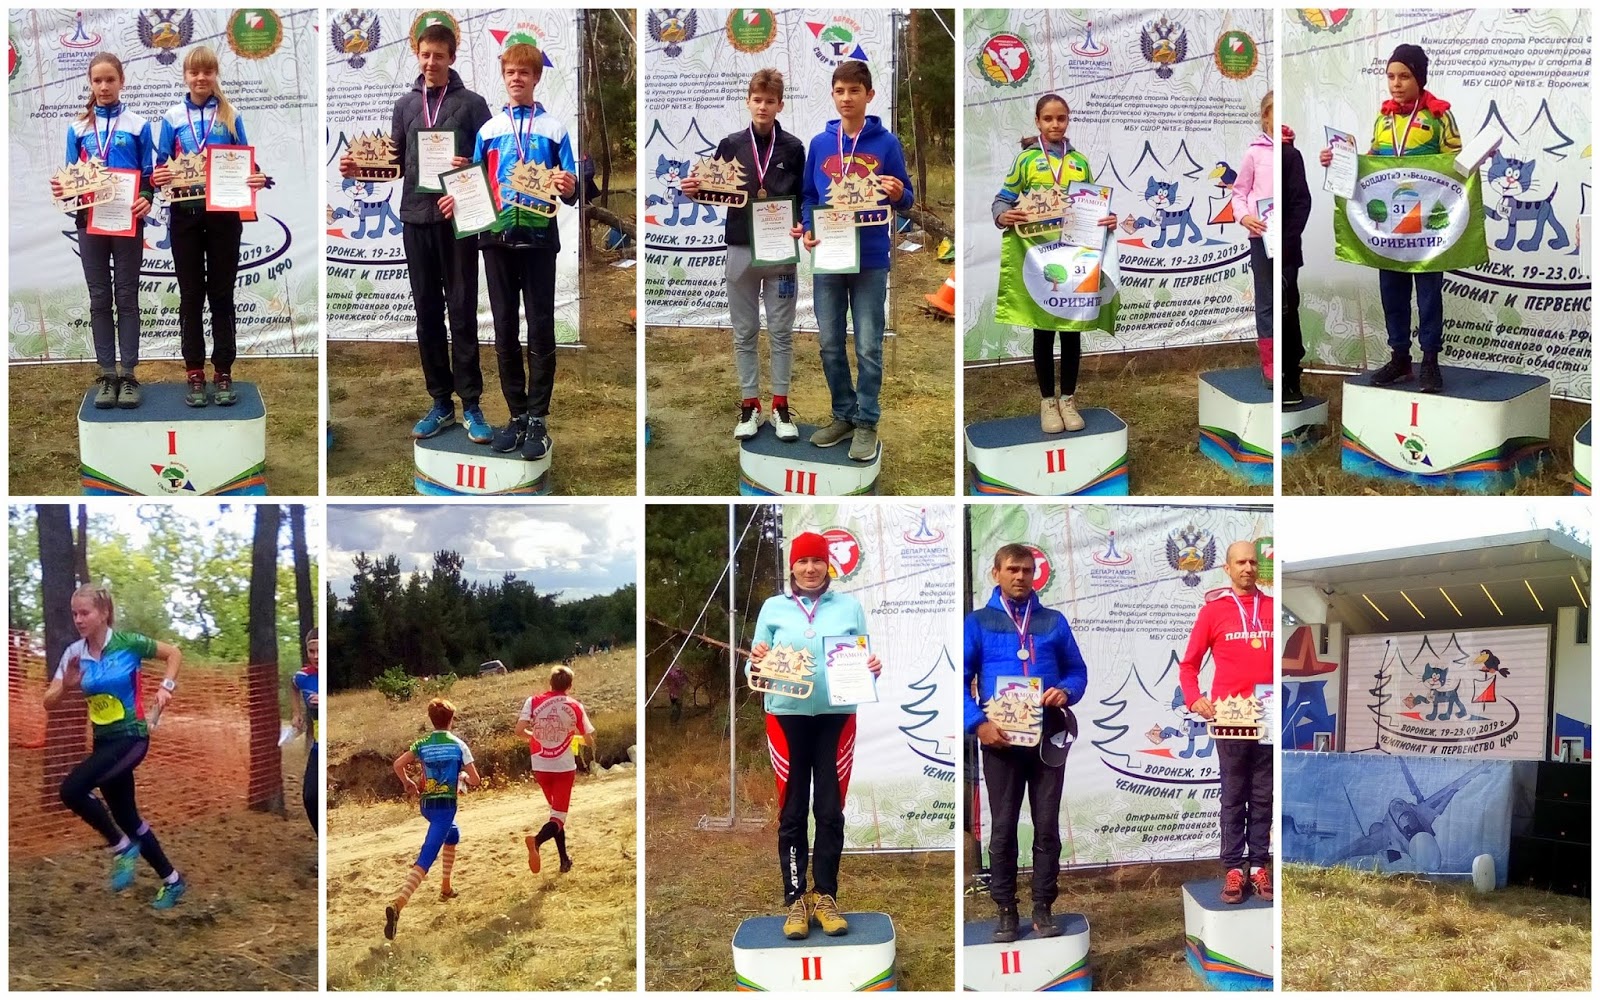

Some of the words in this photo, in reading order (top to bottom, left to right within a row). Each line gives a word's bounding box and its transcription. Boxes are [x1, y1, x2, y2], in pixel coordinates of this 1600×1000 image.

[1421, 37, 1489, 45] Министерство
[1491, 37, 1525, 46] спорта
[1528, 36, 1583, 45] Российской
[1434, 57, 1486, 66] физической
[1446, 69, 1506, 77] спортивного
[1484, 79, 1513, 87] СШОР
[1548, 80, 1589, 88] Воронеж
[1076, 197, 1107, 207] ГРАМОТА
[1393, 204, 1406, 213] 31
[673, 256, 683, 267] И
[1171, 244, 1238, 266] 19-23.09.2019
[267, 258, 292, 280] ЦФО
[361, 270, 370, 280] И
[1074, 265, 1086, 274] 31
[667, 278, 717, 287] фестиваль
[1158, 277, 1168, 288] И
[1173, 268, 1236, 288] ПЕРВЕНСТВО
[355, 292, 405, 301] фестиваль
[645, 288, 701, 297] спортивного
[333, 303, 389, 311] спортивного
[1153, 299, 1201, 310] фестиваль
[1204, 295, 1232, 305] РФСОО
[1504, 293, 1518, 308] И
[1129, 311, 1186, 321] спортивного
[1116, 318, 1173, 332] Воронежской
[1496, 324, 1564, 340] фестиваль
[1463, 334, 1543, 352] спортивного
[1445, 345, 1524, 365] Воронежской
[1410, 402, 1419, 427] I
[167, 431, 176, 455] I
[1046, 448, 1068, 474] II
[456, 463, 488, 490] III
[784, 468, 818, 496] III
[1401, 724, 1437, 737] ВОРОНЕЖ,
[1441, 721, 1499, 736] 19-23.09.2019
[1380, 734, 1426, 754] ЧЕМПИОНАТ
[1430, 746, 1438, 754] И
[1441, 741, 1495, 754] ПЕРВЕНСТВО
[1500, 731, 1519, 748] ЦФО
[1145, 764, 1195, 778] ВОРОНЕЖ,
[1116, 778, 1183, 799] ЧЕМПИОНАТ
[1188, 789, 1197, 799] И
[1126, 811, 1179, 822] Открытый
[1094, 824, 1154, 834] «Федерации
[1157, 822, 1216, 833] спортивного
[1142, 831, 1203, 843] Воронежской
[790, 846, 799, 888] ATOMIC
[801, 957, 822, 981] II
[1000, 950, 1022, 974] II
